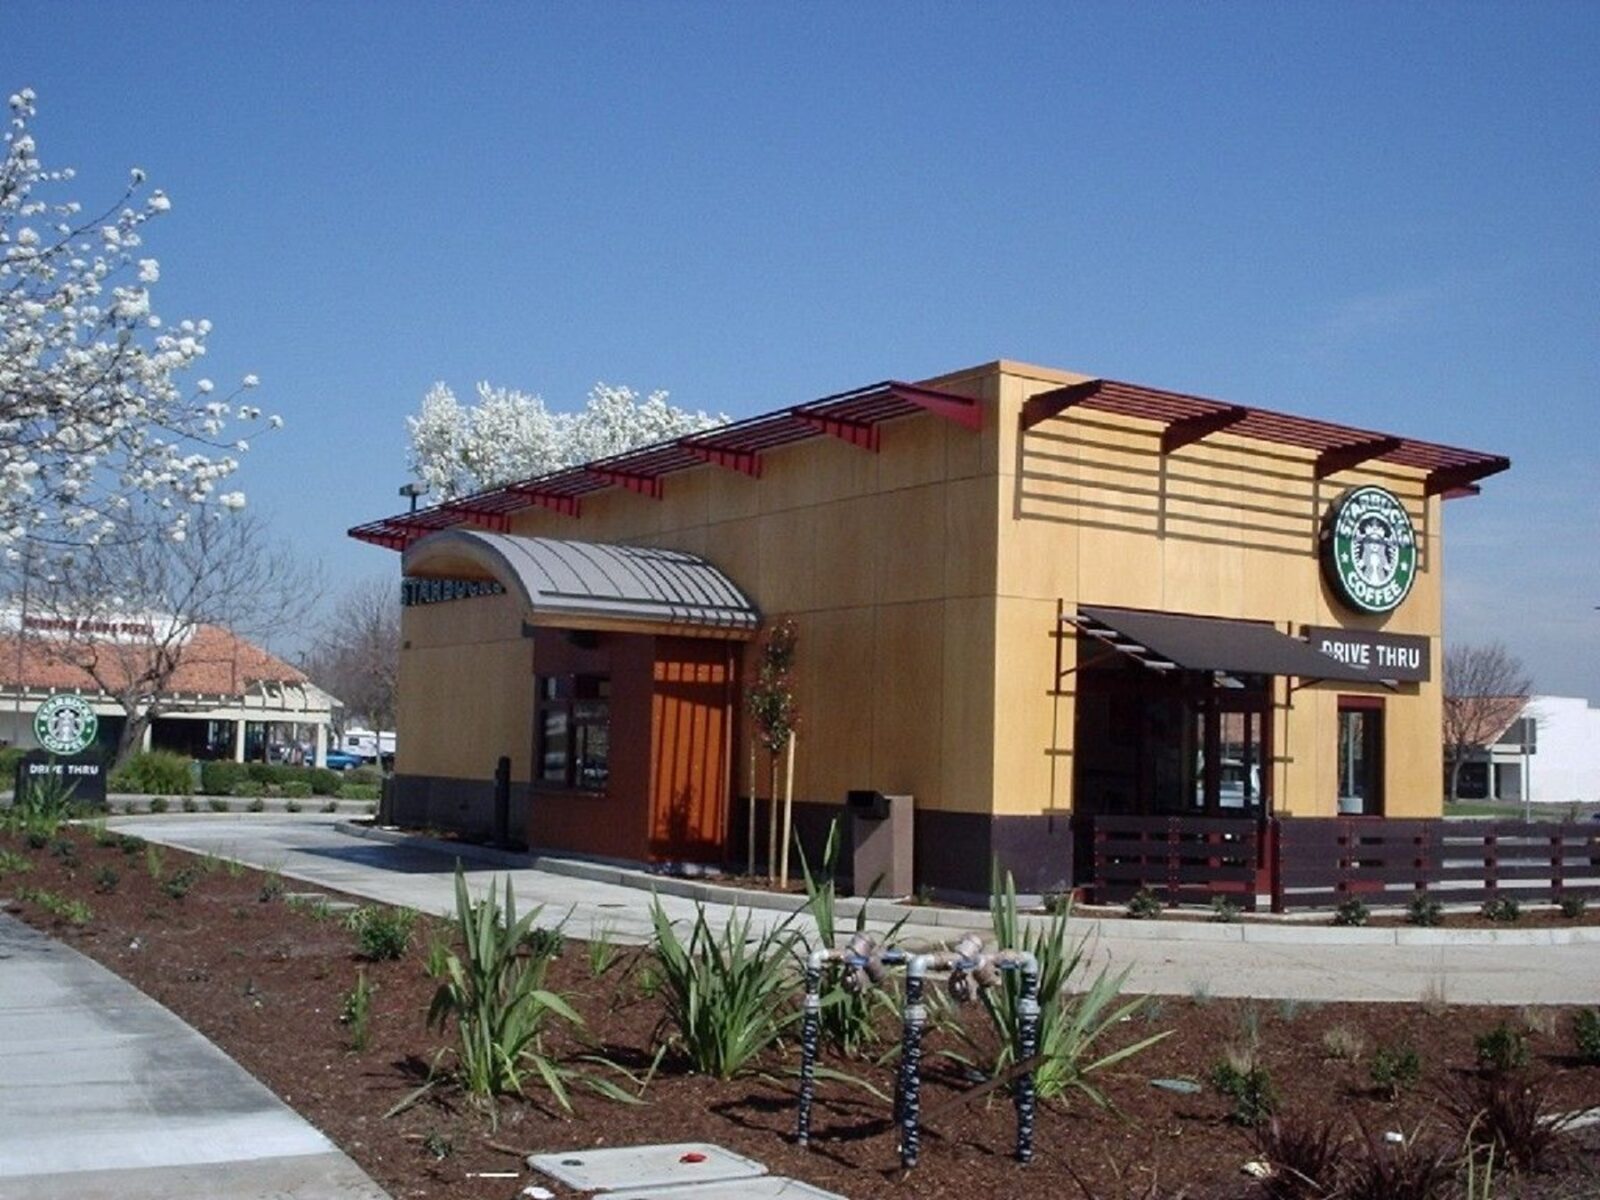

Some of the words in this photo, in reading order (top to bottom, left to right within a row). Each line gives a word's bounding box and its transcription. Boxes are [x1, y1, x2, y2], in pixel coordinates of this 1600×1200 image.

[1340, 494, 1411, 546] STARBUCKS
[1348, 571, 1402, 605] COFFEE
[1320, 640, 1371, 665] DRIVE
[1376, 645, 1420, 670] THRU
[44, 734, 86, 751] COFFEE
[68, 764, 99, 775] THRU
